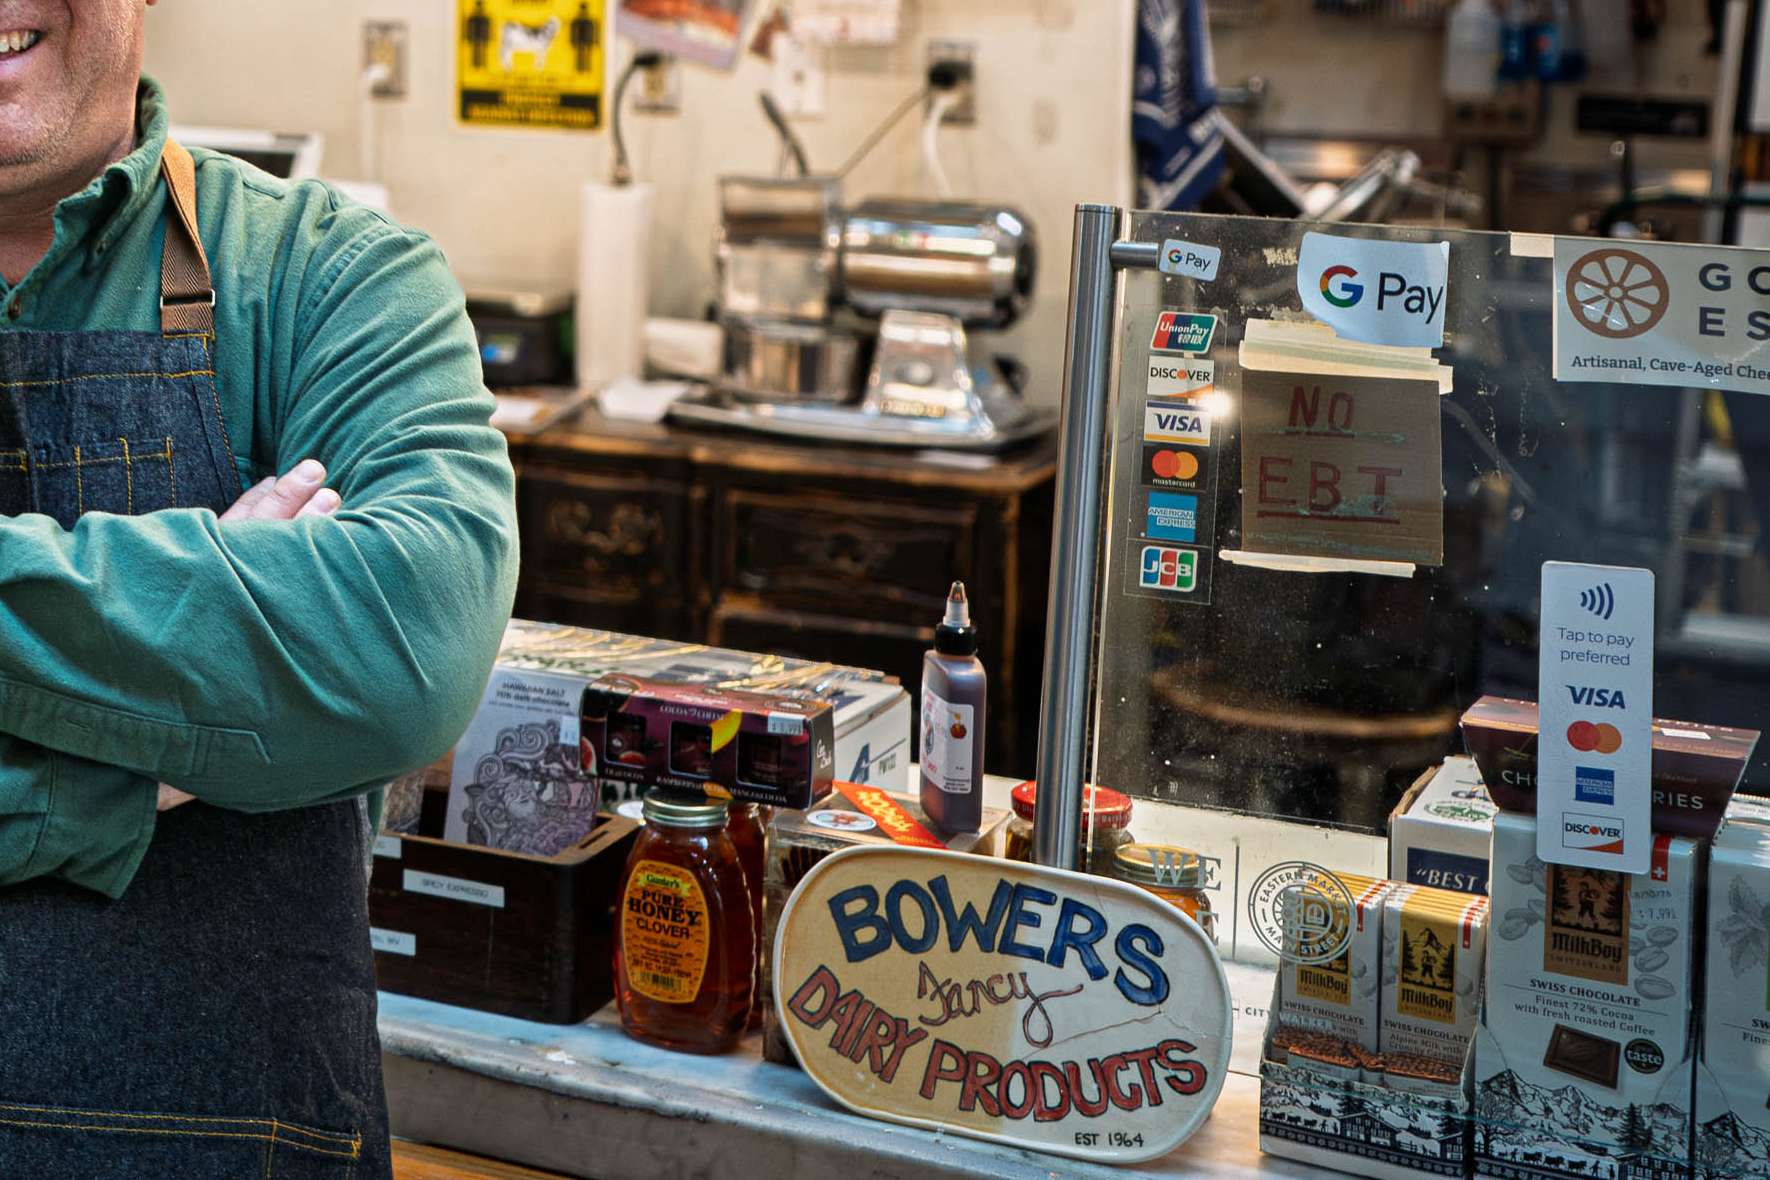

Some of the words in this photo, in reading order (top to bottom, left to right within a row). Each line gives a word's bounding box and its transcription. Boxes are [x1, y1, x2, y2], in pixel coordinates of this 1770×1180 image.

[1185, 251, 1211, 272] Pay
[1377, 272, 1444, 325] Pay
[1160, 321, 1209, 339] UnionPay
[1150, 367, 1211, 382] DISCOVER
[1571, 355, 1647, 372] Artisanal,
[1649, 358, 1734, 378] Cave-Aged
[1288, 385, 1355, 432] NO
[1154, 412, 1202, 433] VISA
[1152, 477, 1196, 489] mastercard
[1258, 456, 1403, 516] EBT
[1148, 507, 1194, 519] AMERICAN
[1157, 516, 1197, 529] EXPRESS
[1143, 560, 1192, 577] JCB
[1557, 627, 1585, 643] Tap
[1589, 631, 1604, 643] to
[1606, 634, 1635, 649] pay
[1560, 649, 1631, 666] preferred
[502, 682, 544, 695] HAWAIIAN
[546, 687, 566, 698] SALT
[513, 693, 531, 702] dark
[531, 696, 570, 708] chocolate
[1565, 684, 1627, 709] VISA
[1577, 777, 1613, 789] AMERICAN
[1582, 785, 1614, 797] EXPRESS
[1565, 822, 1621, 838] DISCOVER
[642, 889, 684, 909] PURE
[1259, 870, 1303, 903] EASTERN
[1308, 873, 1347, 917] MARKET
[629, 896, 704, 927] HONEY
[636, 918, 690, 940] CLOVER
[1265, 925, 1298, 953] MAIN
[1301, 933, 1341, 955] STREET
[827, 874, 1171, 1007] BOWERS
[1551, 931, 1623, 963] MilkBoy
[1300, 969, 1349, 995] MilkBoy
[1529, 978, 1566, 994] SWISS
[1569, 986, 1641, 1007] CHOCOLATE
[1402, 987, 1453, 1013] MilkBoy
[1535, 994, 1570, 1009] Finest
[1572, 1001, 1598, 1015] 72%
[1600, 1007, 1634, 1022] Cocoa
[1284, 1001, 1311, 1013] SWISS
[1313, 1006, 1365, 1026] CHOCOLATE
[1514, 1002, 1539, 1015] with
[1542, 1007, 1571, 1022] fresh
[1573, 1014, 1616, 1030] roasted
[1619, 1021, 1655, 1037] Coffee
[1384, 1019, 1413, 1032] SWISS
[1414, 1024, 1470, 1044] CHOCOLATE
[787, 963, 929, 1085] DAIRY
[919, 1037, 1208, 1124] PRODUCTS
[1389, 1033, 1418, 1045] Alpine
[1420, 1038, 1439, 1050] Milk
[1442, 1044, 1463, 1055] with
[1389, 1041, 1425, 1055] Crunchy
[1626, 1051, 1662, 1065] taste
[1074, 1131, 1098, 1147] EST
[1107, 1130, 1146, 1149] 1964
